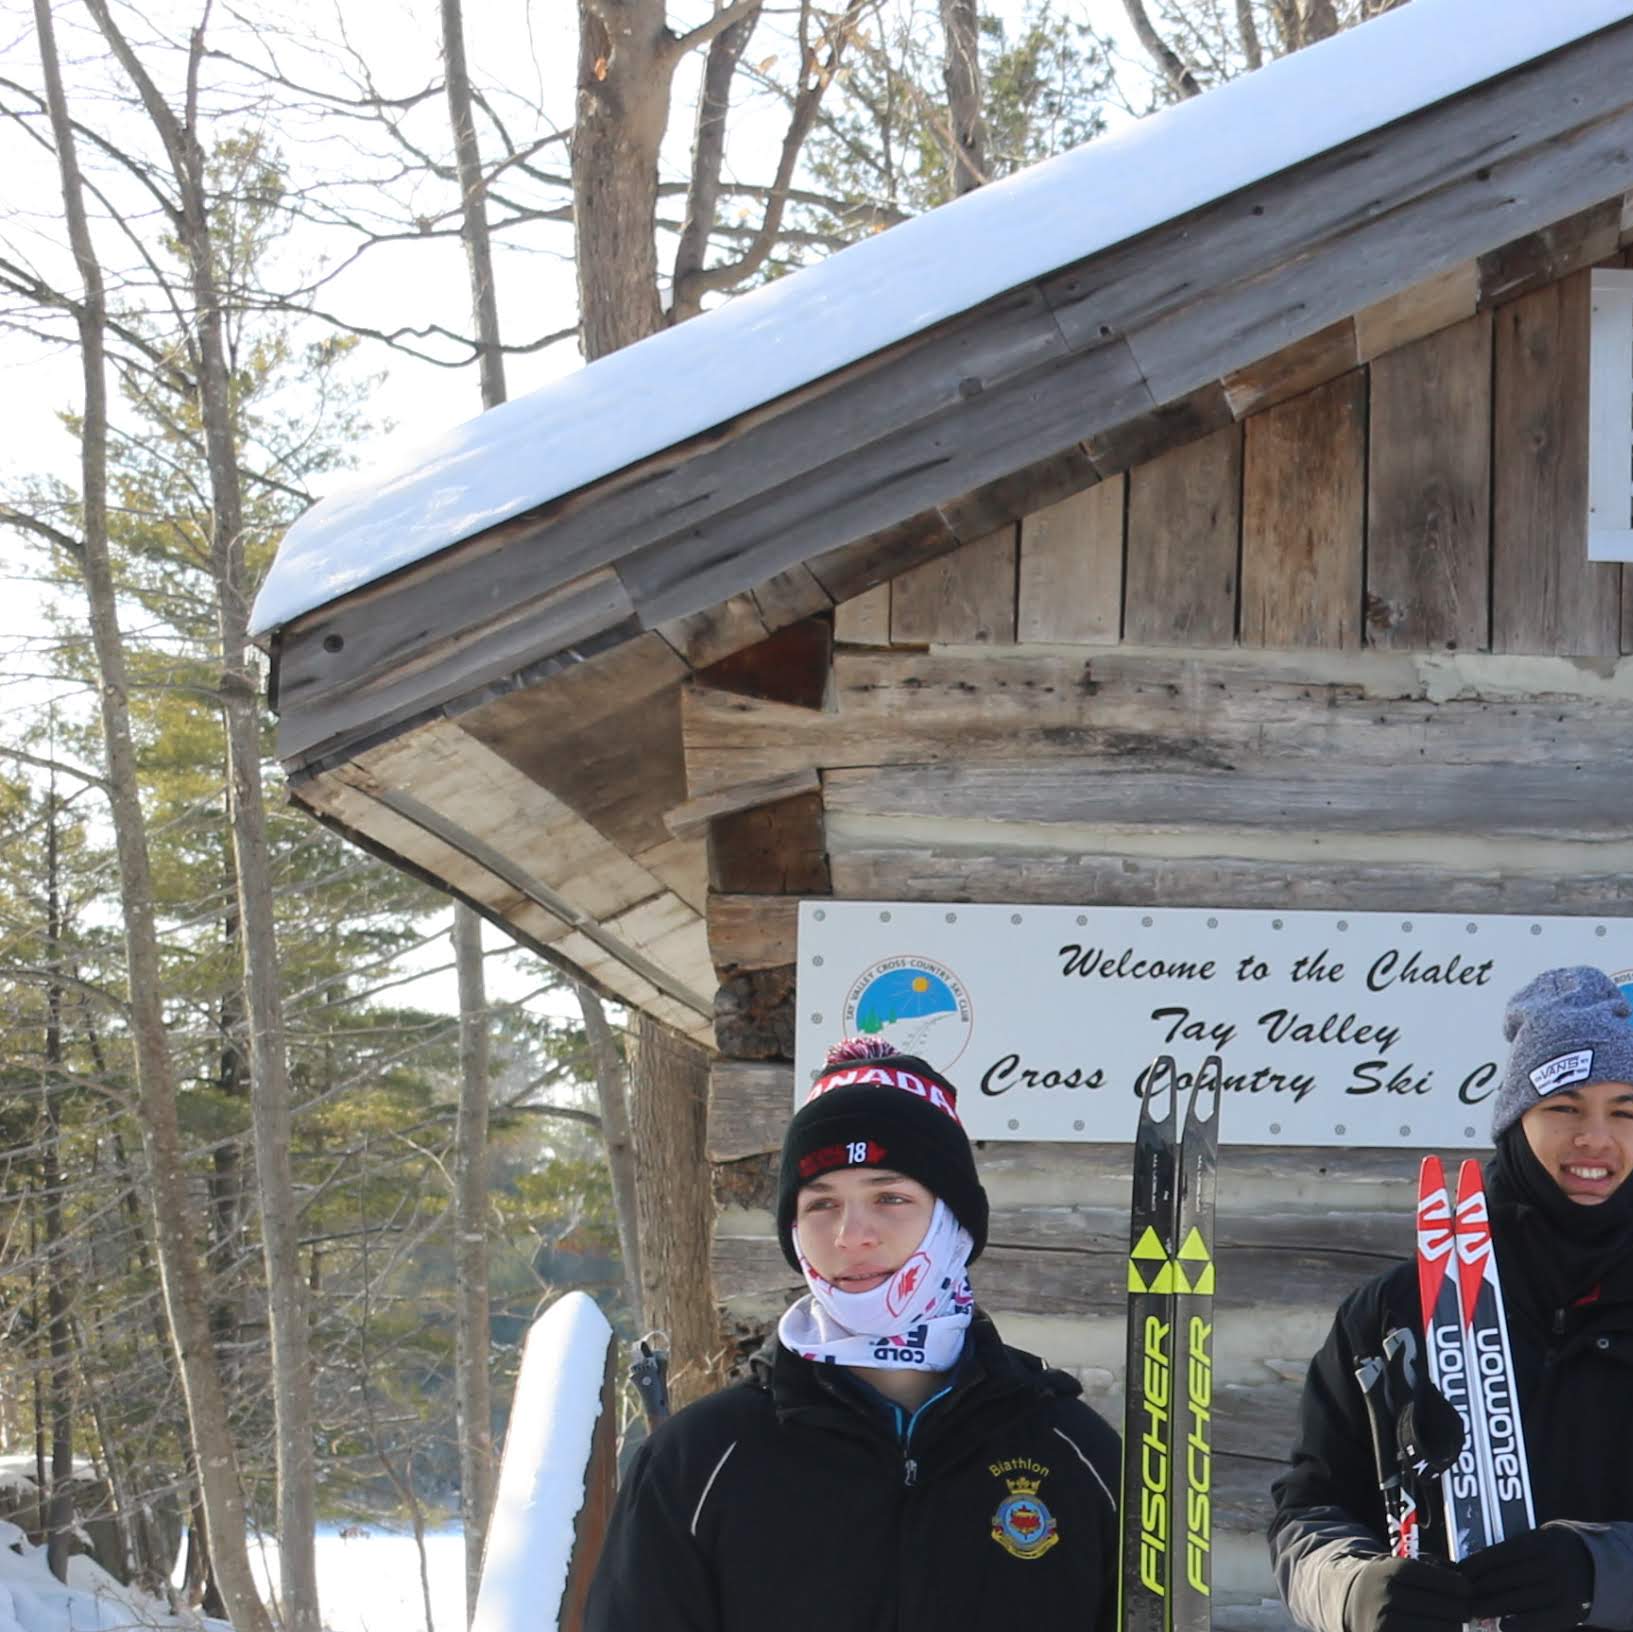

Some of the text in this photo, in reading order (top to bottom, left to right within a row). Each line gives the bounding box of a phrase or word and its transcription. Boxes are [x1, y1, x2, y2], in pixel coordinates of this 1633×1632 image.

[1058, 943, 1495, 992] Welcome to the Chalet
[1151, 1006, 1400, 1054] Tay Valley
[980, 1054, 1503, 1105] Cross Country Ski C
[1540, 1055, 1579, 1079] VANS
[846, 1142, 867, 1164] 18
[873, 1347, 926, 1365] COLD
[989, 1458, 1050, 1477] Biathlon
[1140, 1315, 1171, 1597] FISCHER
[1186, 1316, 1212, 1597] FISCHER
